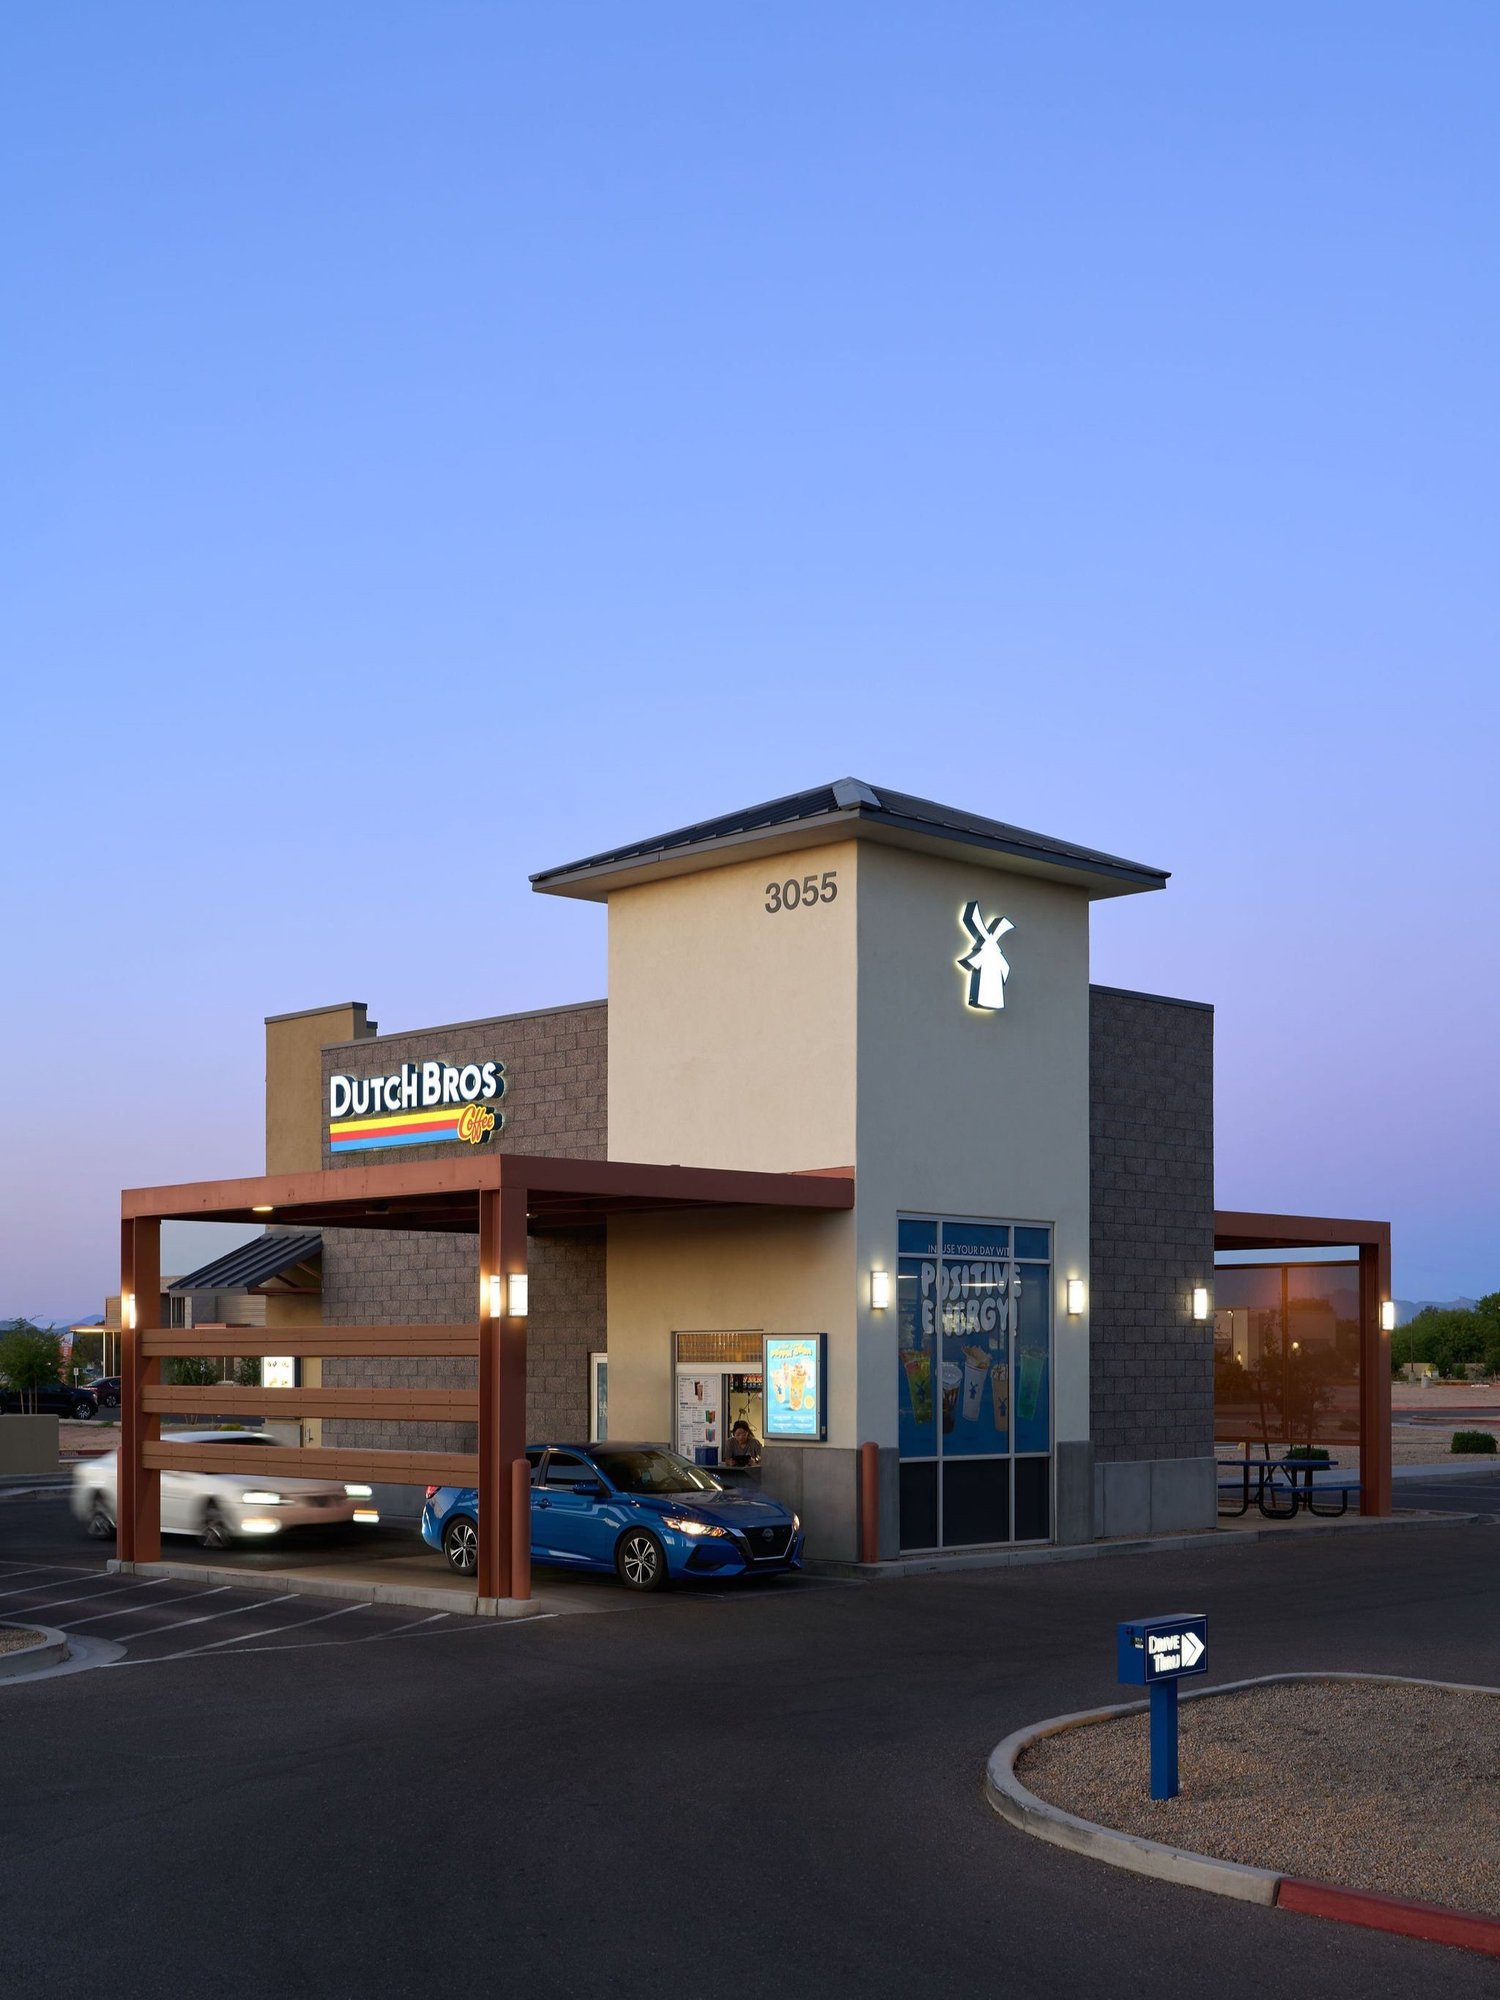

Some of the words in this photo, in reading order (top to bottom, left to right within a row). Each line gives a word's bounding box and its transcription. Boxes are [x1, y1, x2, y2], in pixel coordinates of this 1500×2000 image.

[765, 871, 838, 913] 3055
[330, 1063, 418, 1117] DUTCH
[422, 1062, 498, 1105] BROS
[458, 1104, 495, 1143] Coffee
[928, 1244, 955, 1254] INUSE
[956, 1244, 979, 1255] YOUR
[980, 1245, 995, 1256] DAY
[996, 1246, 1010, 1257] WIT
